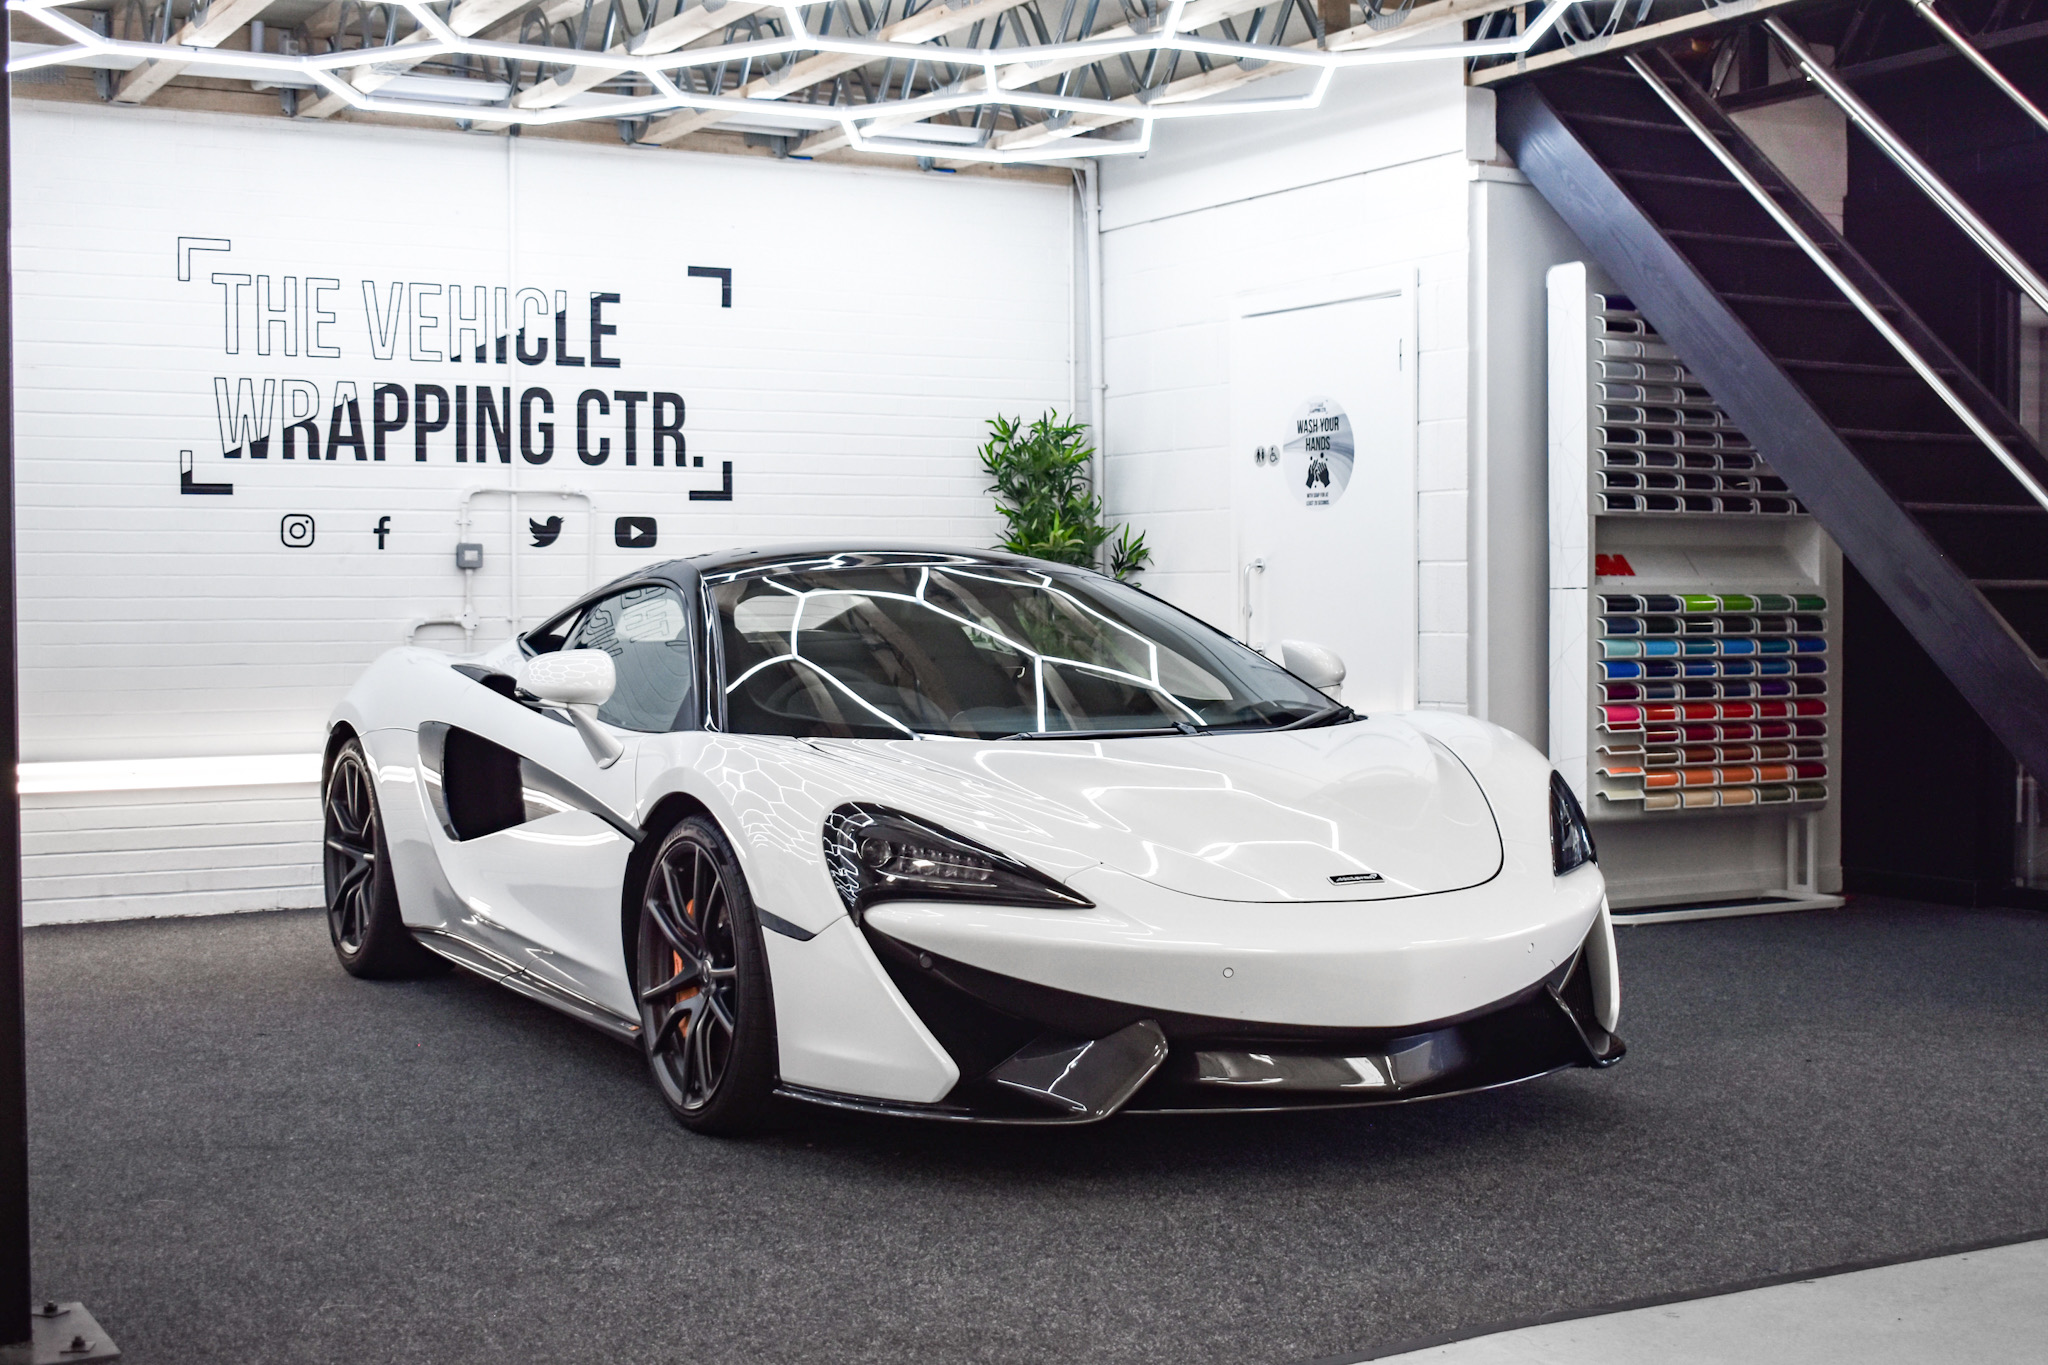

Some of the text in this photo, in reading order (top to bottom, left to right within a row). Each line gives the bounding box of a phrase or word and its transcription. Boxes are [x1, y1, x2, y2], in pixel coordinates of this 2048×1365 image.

[212, 273, 621, 368] THE VEHICLE
[213, 377, 704, 467] WRAPPING CTR.
[1297, 417, 1339, 434] WASH YOUR
[1306, 436, 1331, 451] HANDS
